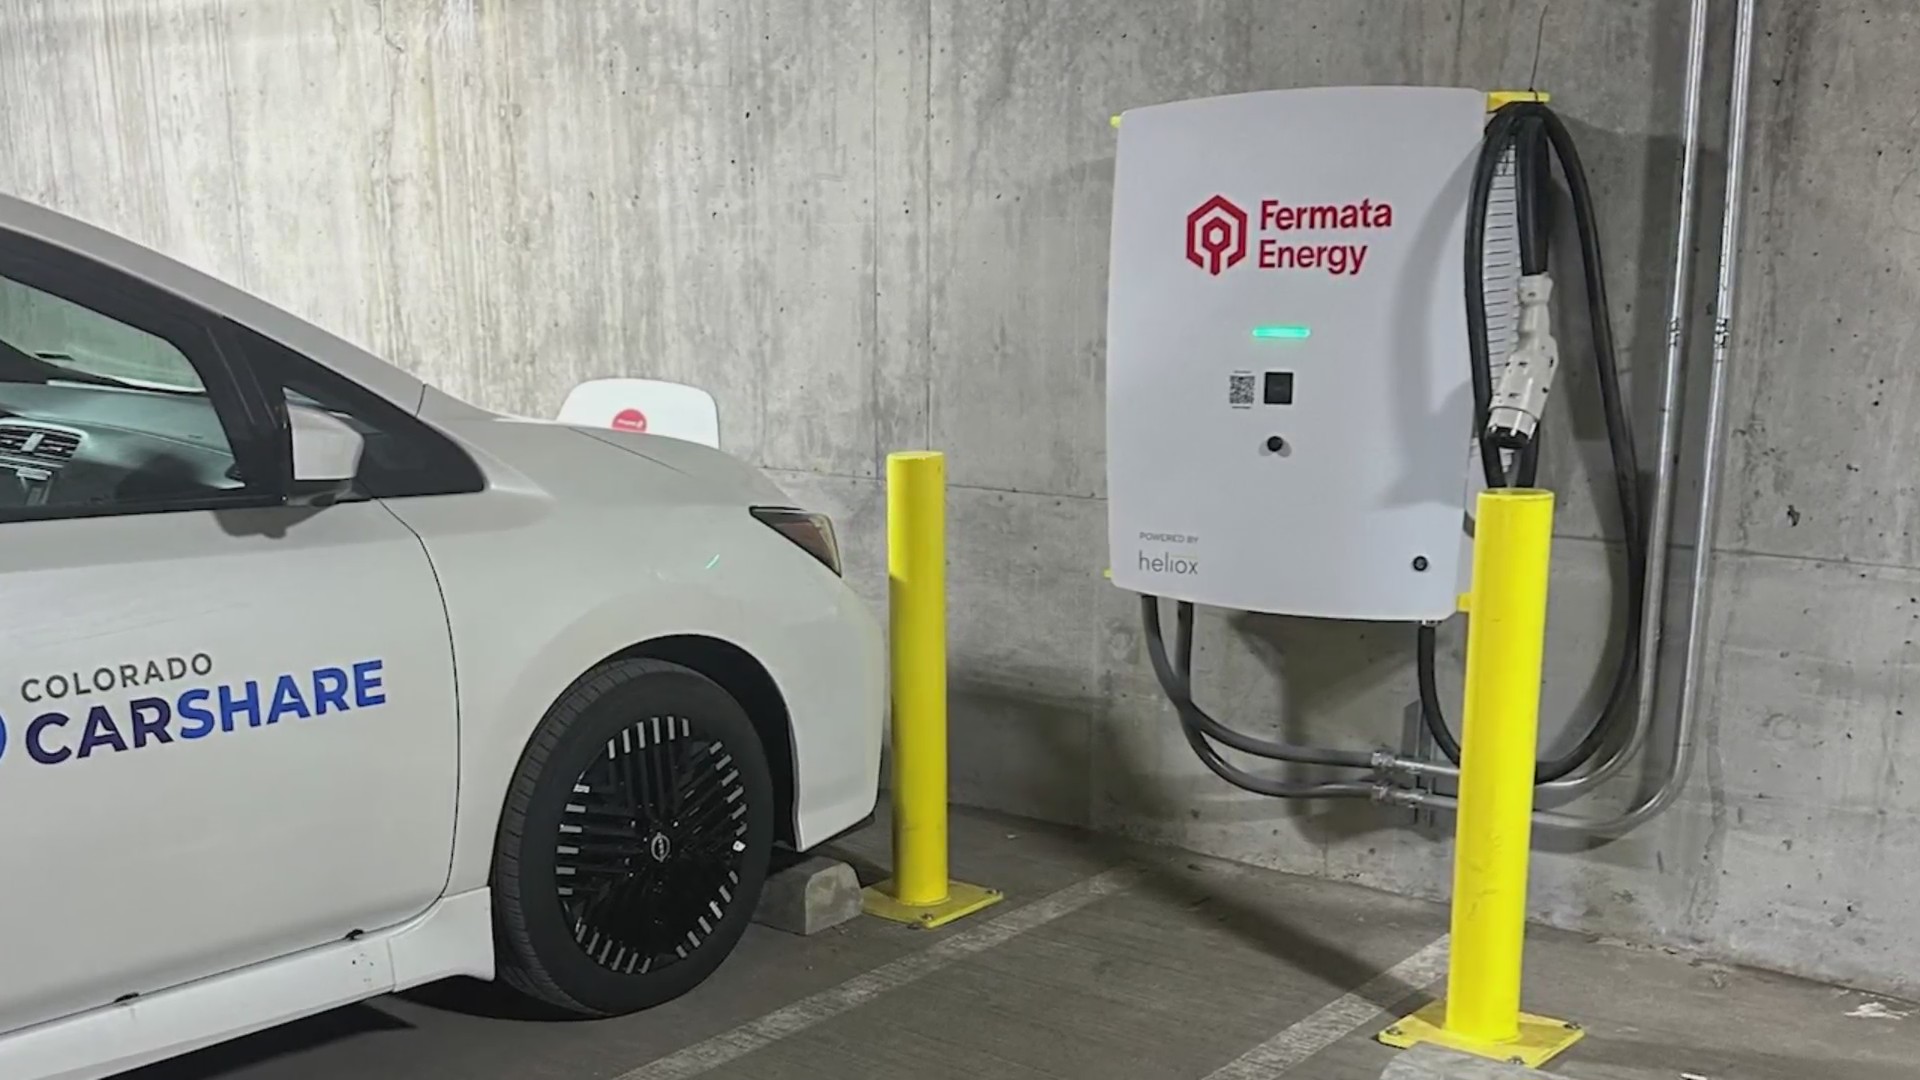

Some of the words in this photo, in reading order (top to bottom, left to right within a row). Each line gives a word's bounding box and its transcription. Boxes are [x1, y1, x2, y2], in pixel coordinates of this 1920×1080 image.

[1260, 198, 1393, 231] Fermata
[1259, 239, 1368, 275] Energy
[1139, 549, 1199, 575] heliox
[20, 652, 213, 703] COLORADO
[24, 659, 387, 765] CARSHARE
